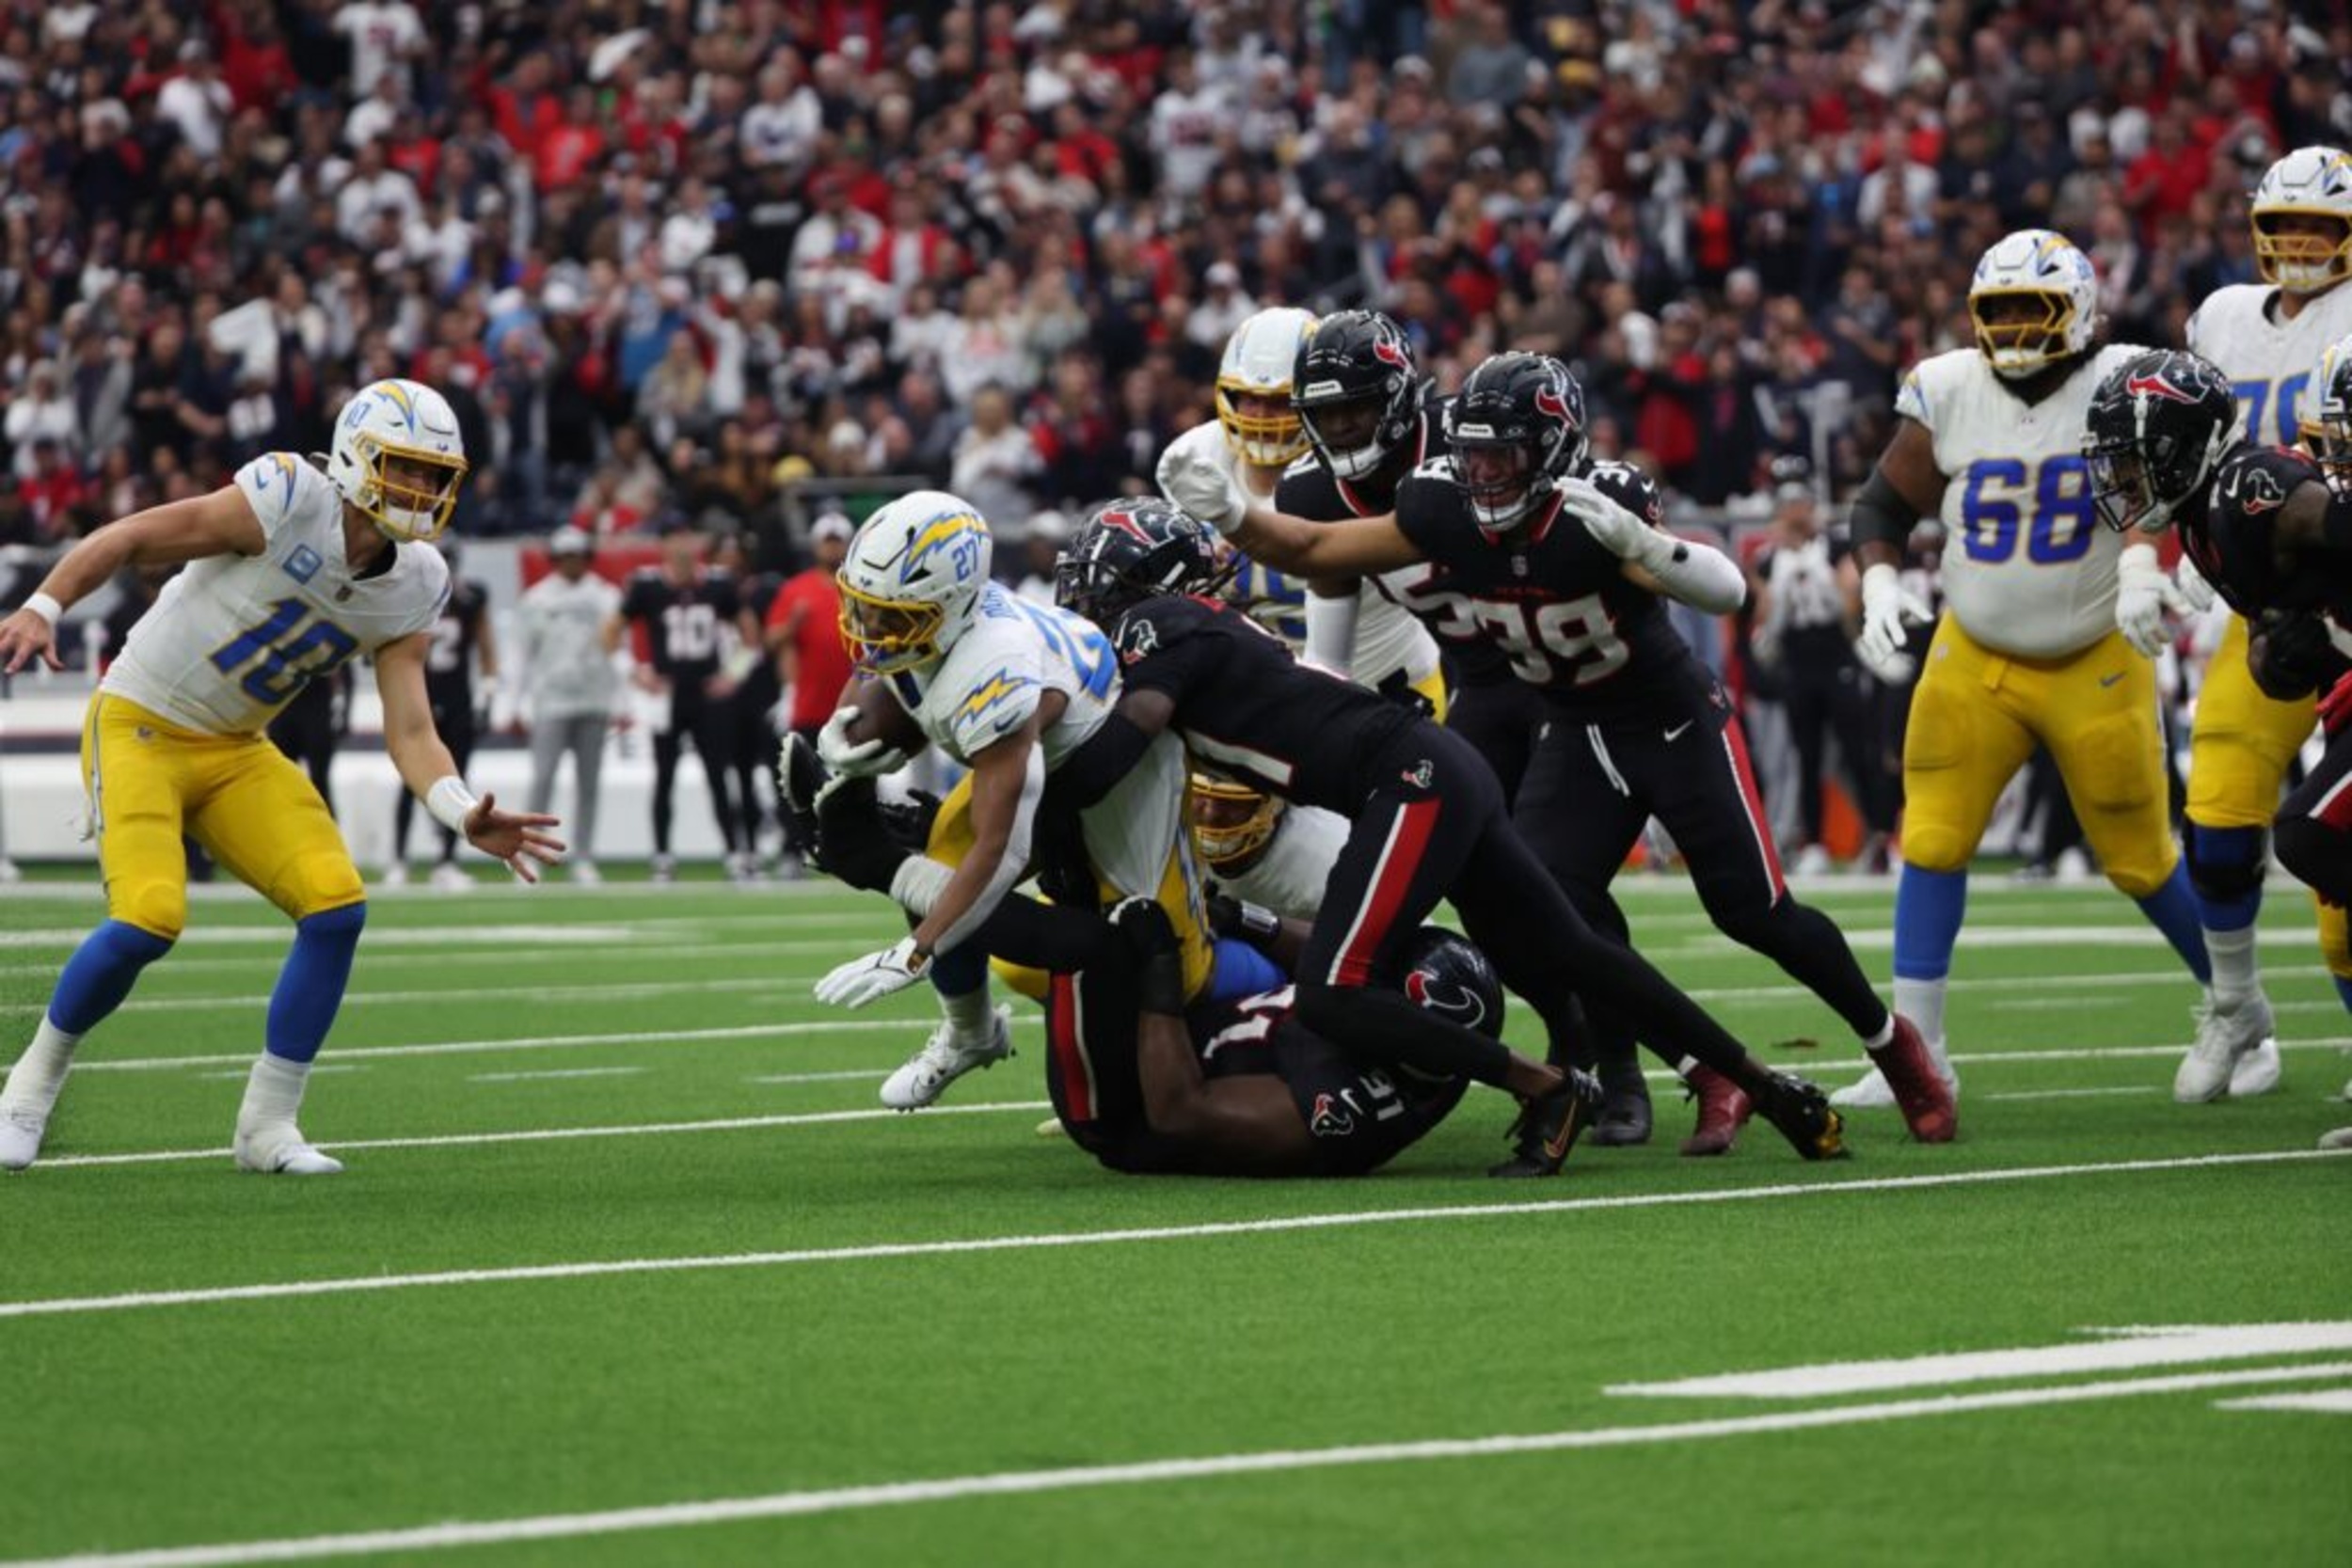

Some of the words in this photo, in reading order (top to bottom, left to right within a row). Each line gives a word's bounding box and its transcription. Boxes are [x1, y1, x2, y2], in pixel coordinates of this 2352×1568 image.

[951, 537, 978, 582] 27
[1962, 453, 2098, 566] 68
[208, 596, 360, 705] 10
[1470, 593, 1630, 686] 39
